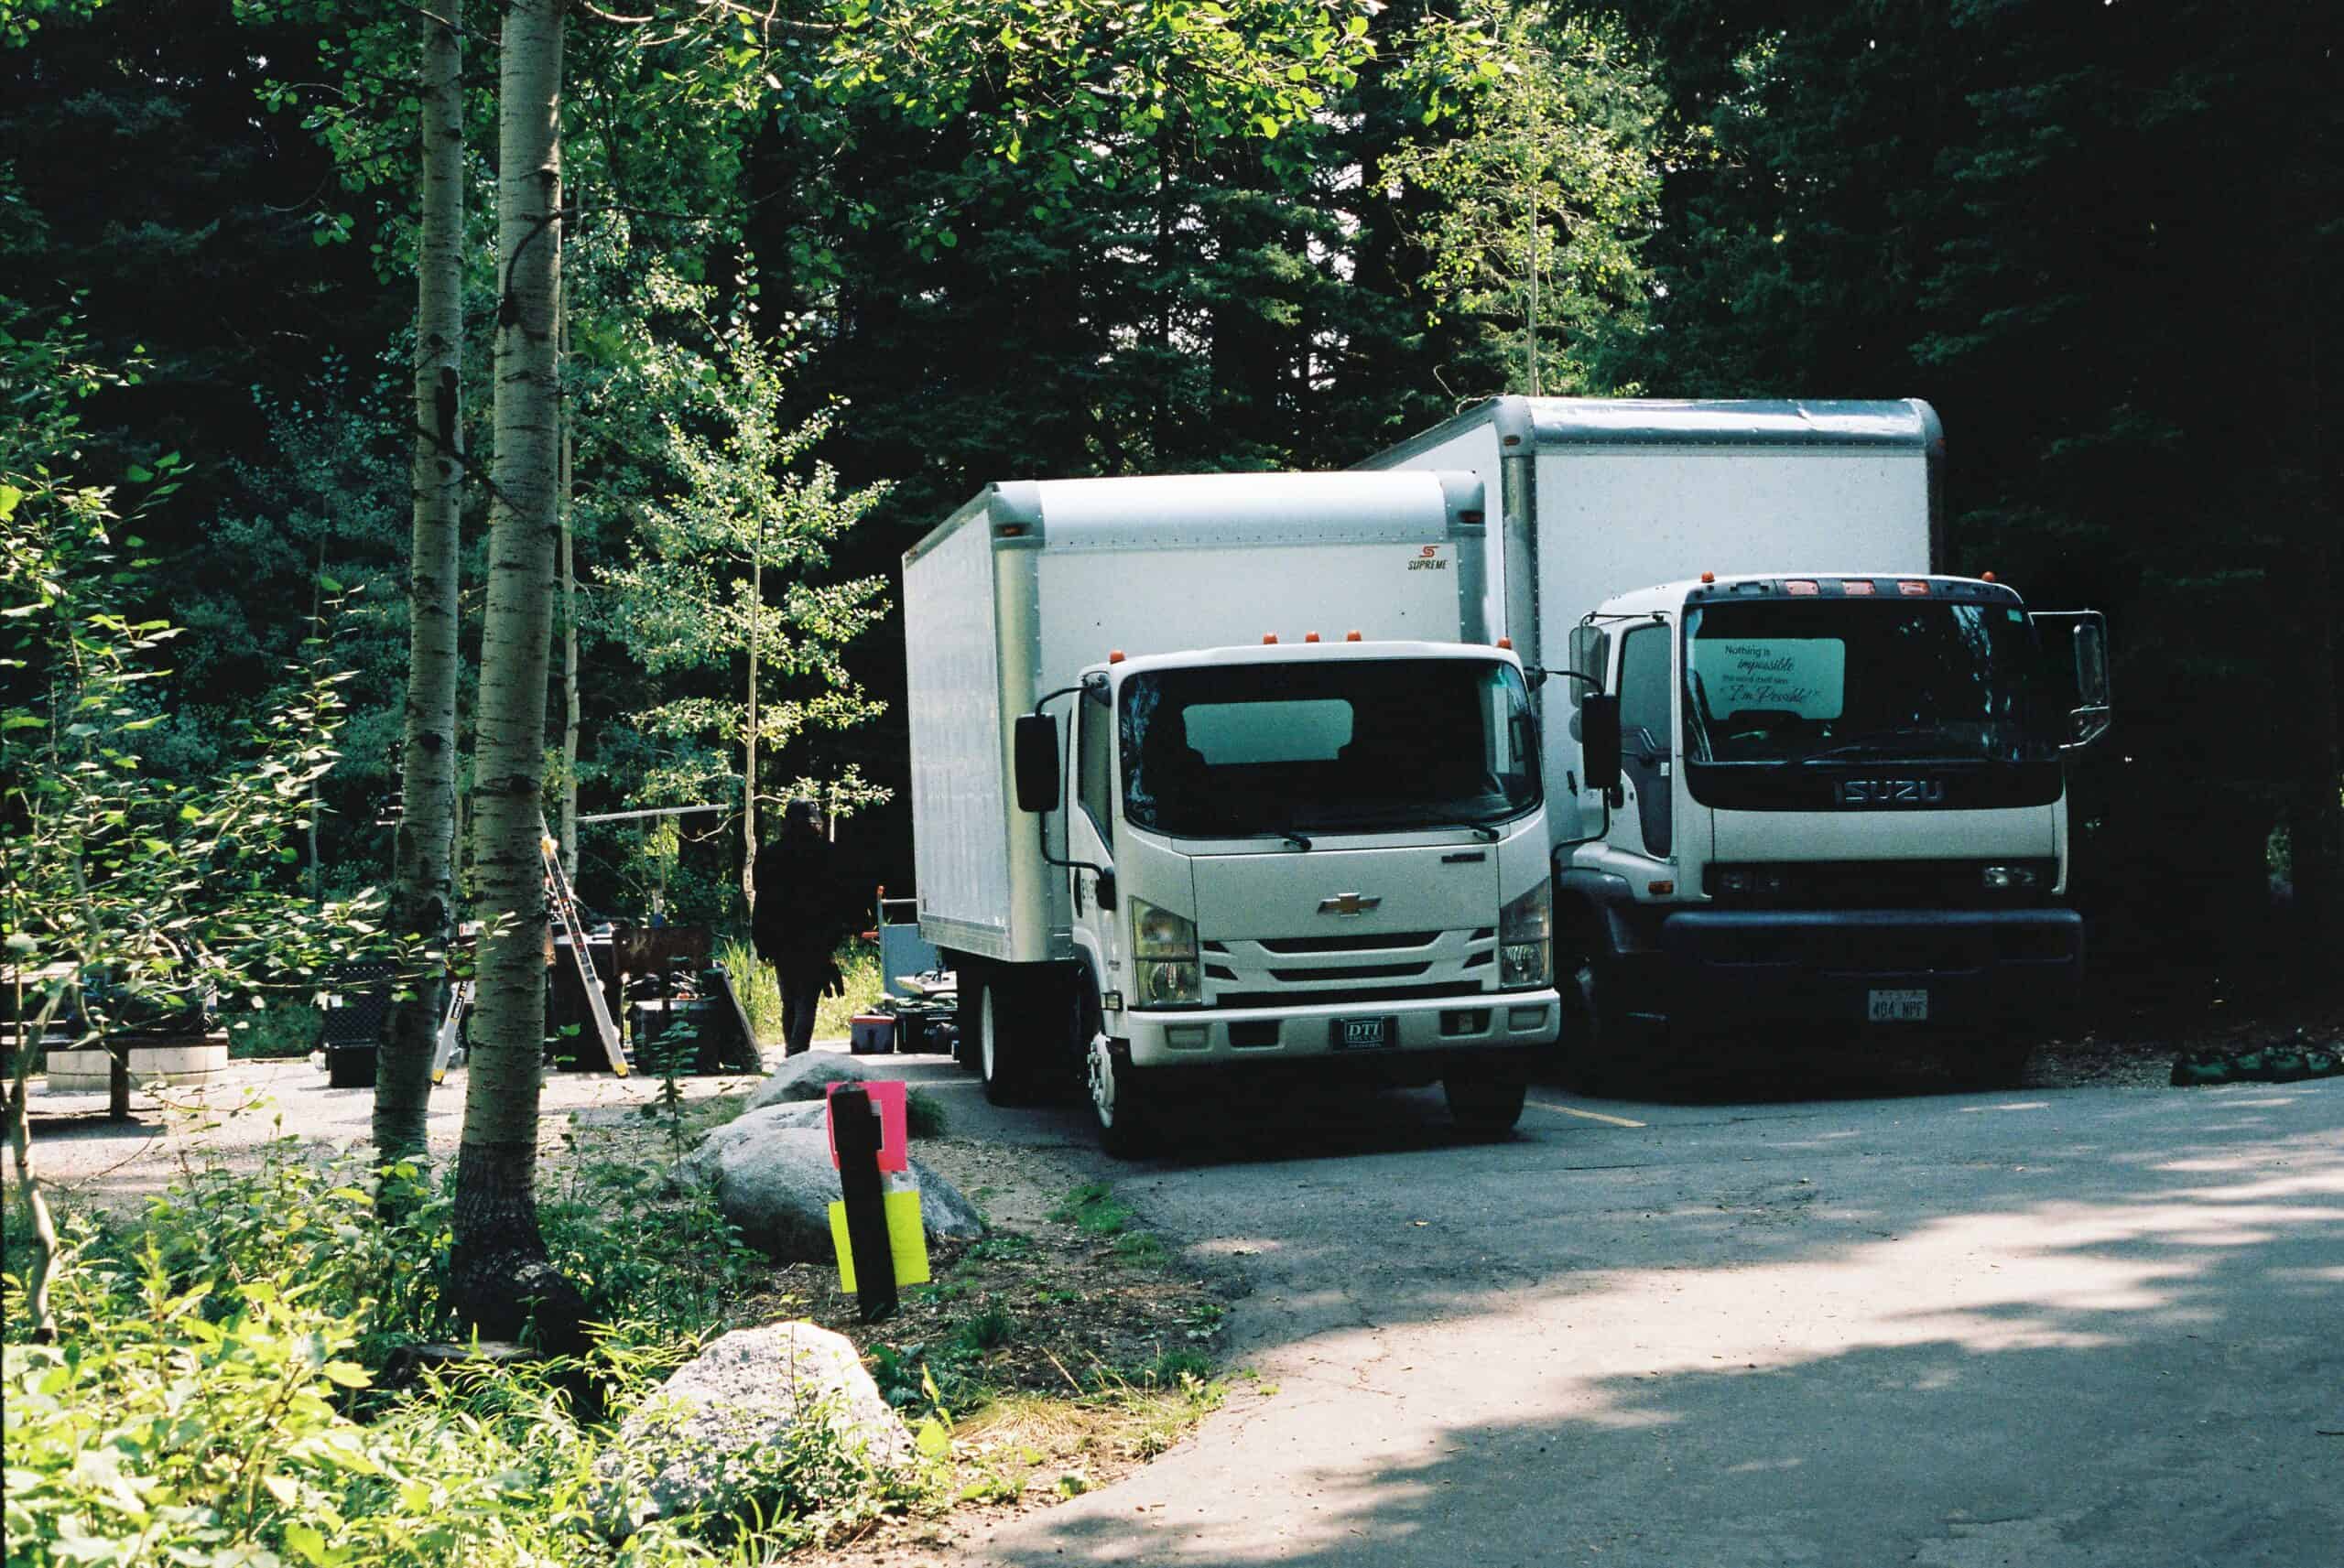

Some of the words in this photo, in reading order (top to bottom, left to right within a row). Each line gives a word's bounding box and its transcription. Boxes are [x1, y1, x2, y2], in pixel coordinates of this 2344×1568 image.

[1407, 559, 1449, 570] SUPREME
[1725, 643, 1761, 657] Nothing
[1763, 648, 1771, 656] is
[1737, 657, 1795, 675] impossible
[1834, 781, 1942, 805] ISUZU
